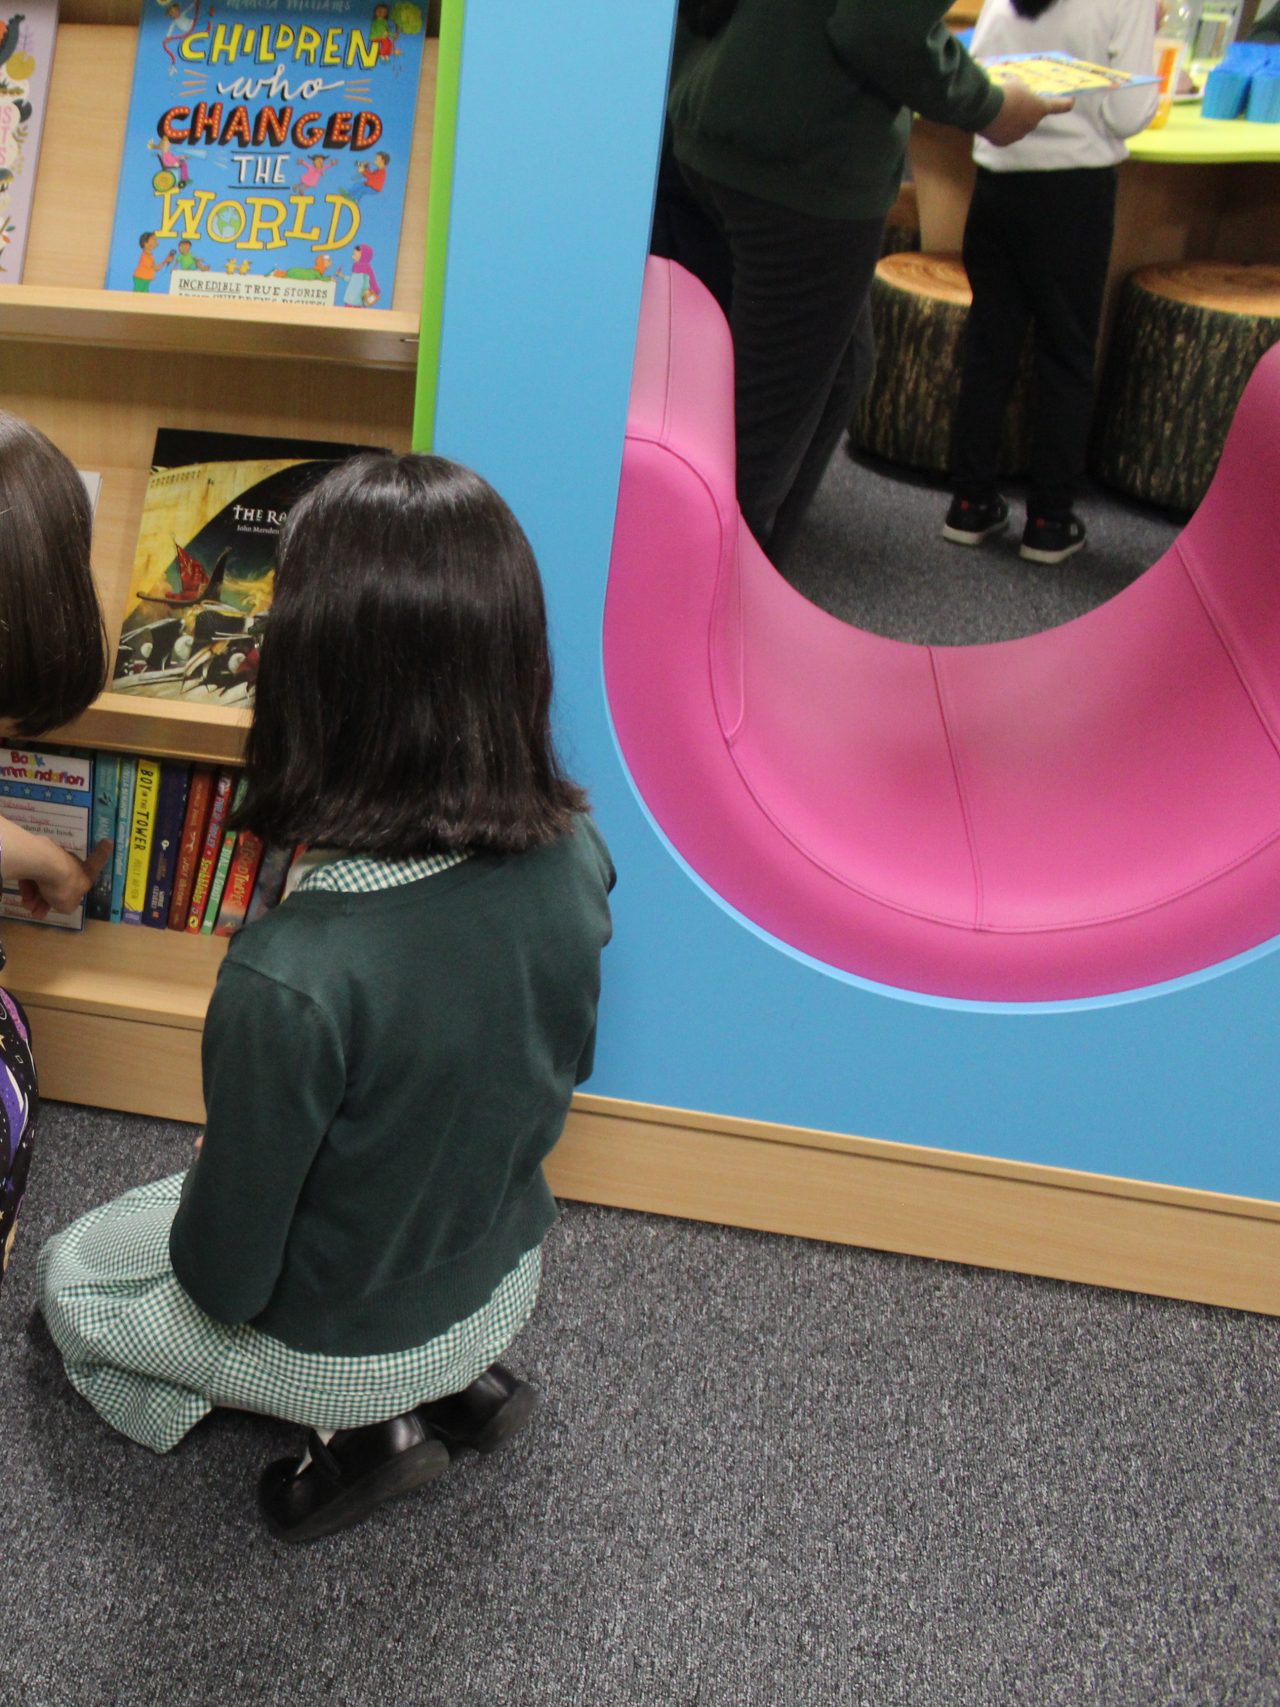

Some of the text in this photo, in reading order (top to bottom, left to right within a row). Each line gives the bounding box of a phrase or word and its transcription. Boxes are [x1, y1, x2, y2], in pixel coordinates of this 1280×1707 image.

[179, 23, 381, 69] CHILDREN
[218, 63, 345, 100] who
[158, 101, 383, 149] CHANGED
[236, 153, 288, 185] THE
[154, 187, 362, 252] WORLD
[178, 278, 241, 294] INCREDIBLE
[245, 284, 281, 297] TRUE
[284, 287, 328, 300] STORIES
[233, 504, 264, 521] THE
[10, 750, 46, 767] Book
[139, 768, 154, 791] BOY
[134, 811, 150, 851] TOWER
